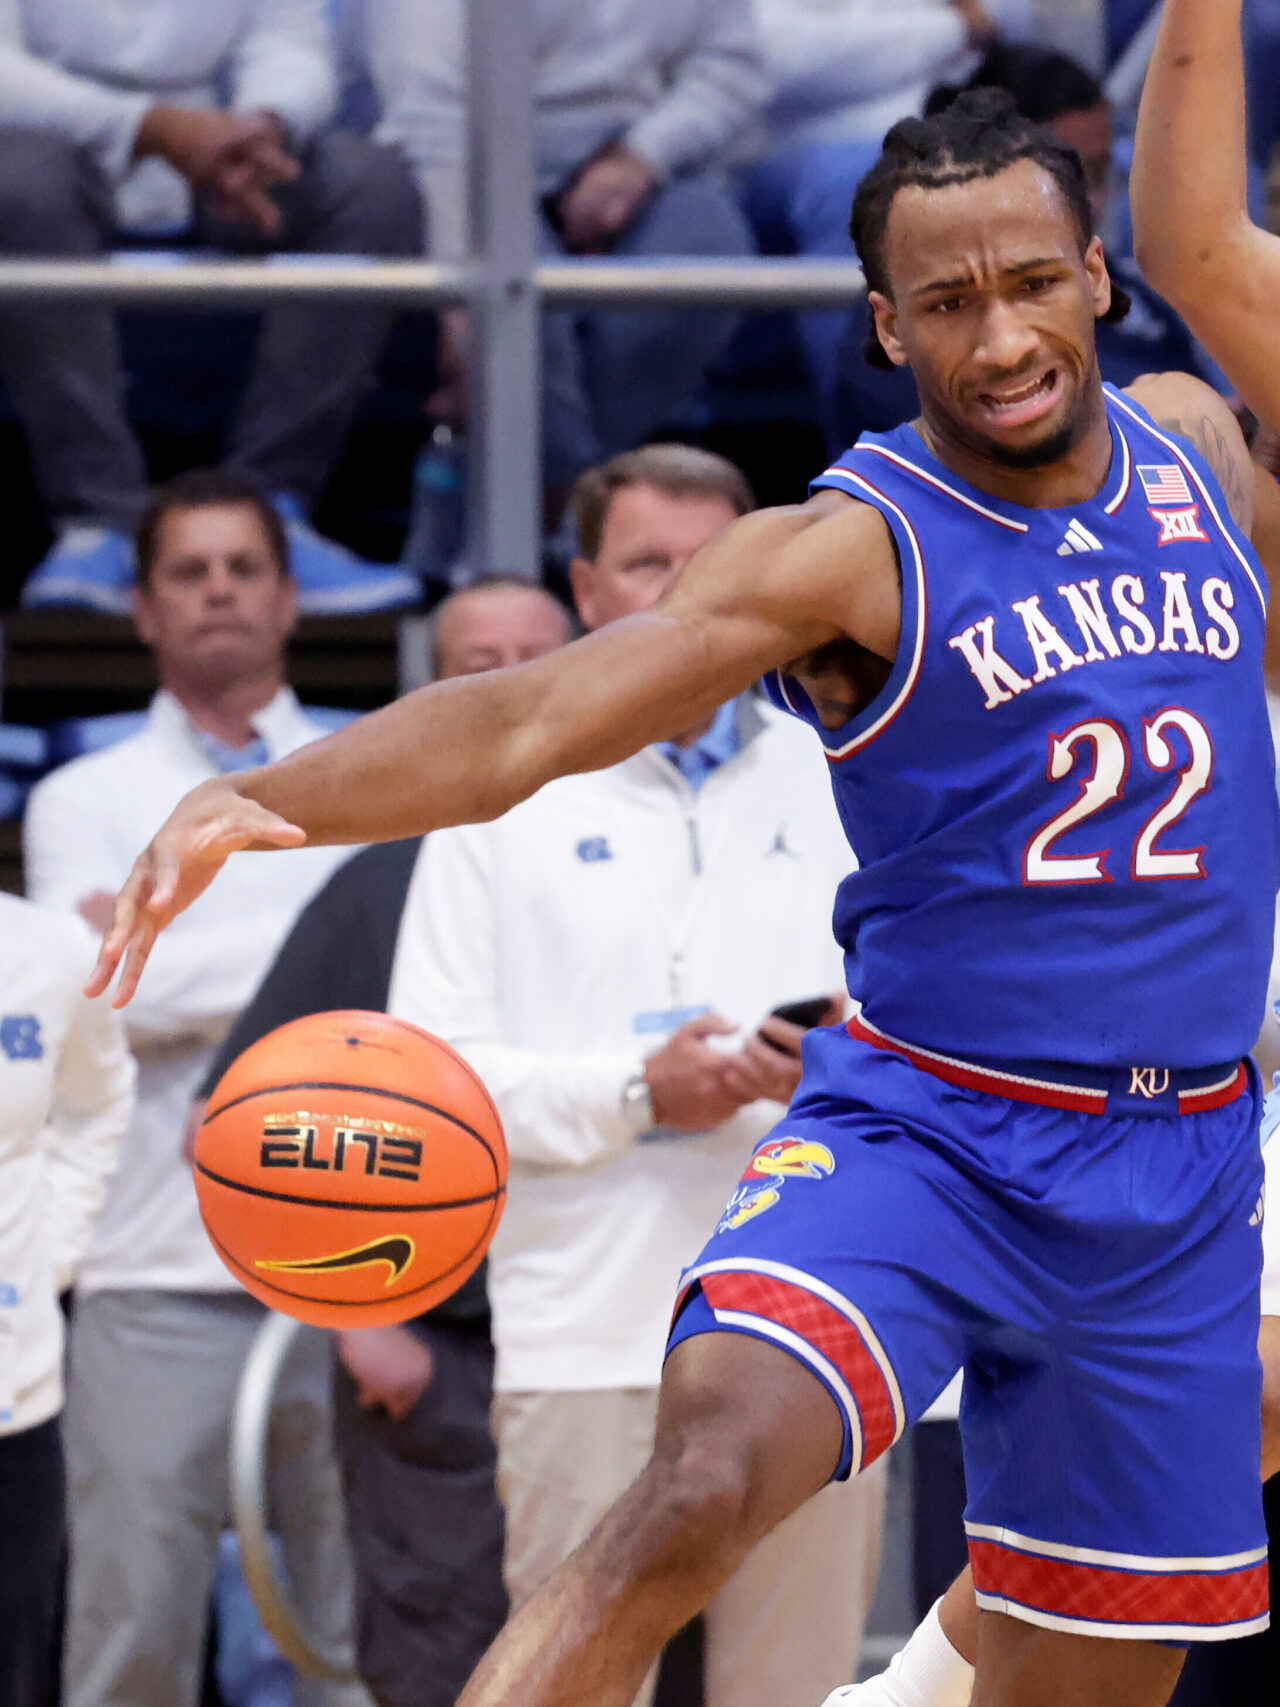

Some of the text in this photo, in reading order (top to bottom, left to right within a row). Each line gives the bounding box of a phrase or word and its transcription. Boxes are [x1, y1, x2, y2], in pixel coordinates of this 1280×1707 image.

[948, 570, 1241, 711] KANSAS
[1022, 705, 1214, 886] 22
[1127, 1066, 1170, 1099] KU
[260, 1127, 424, 1182] ELITE
